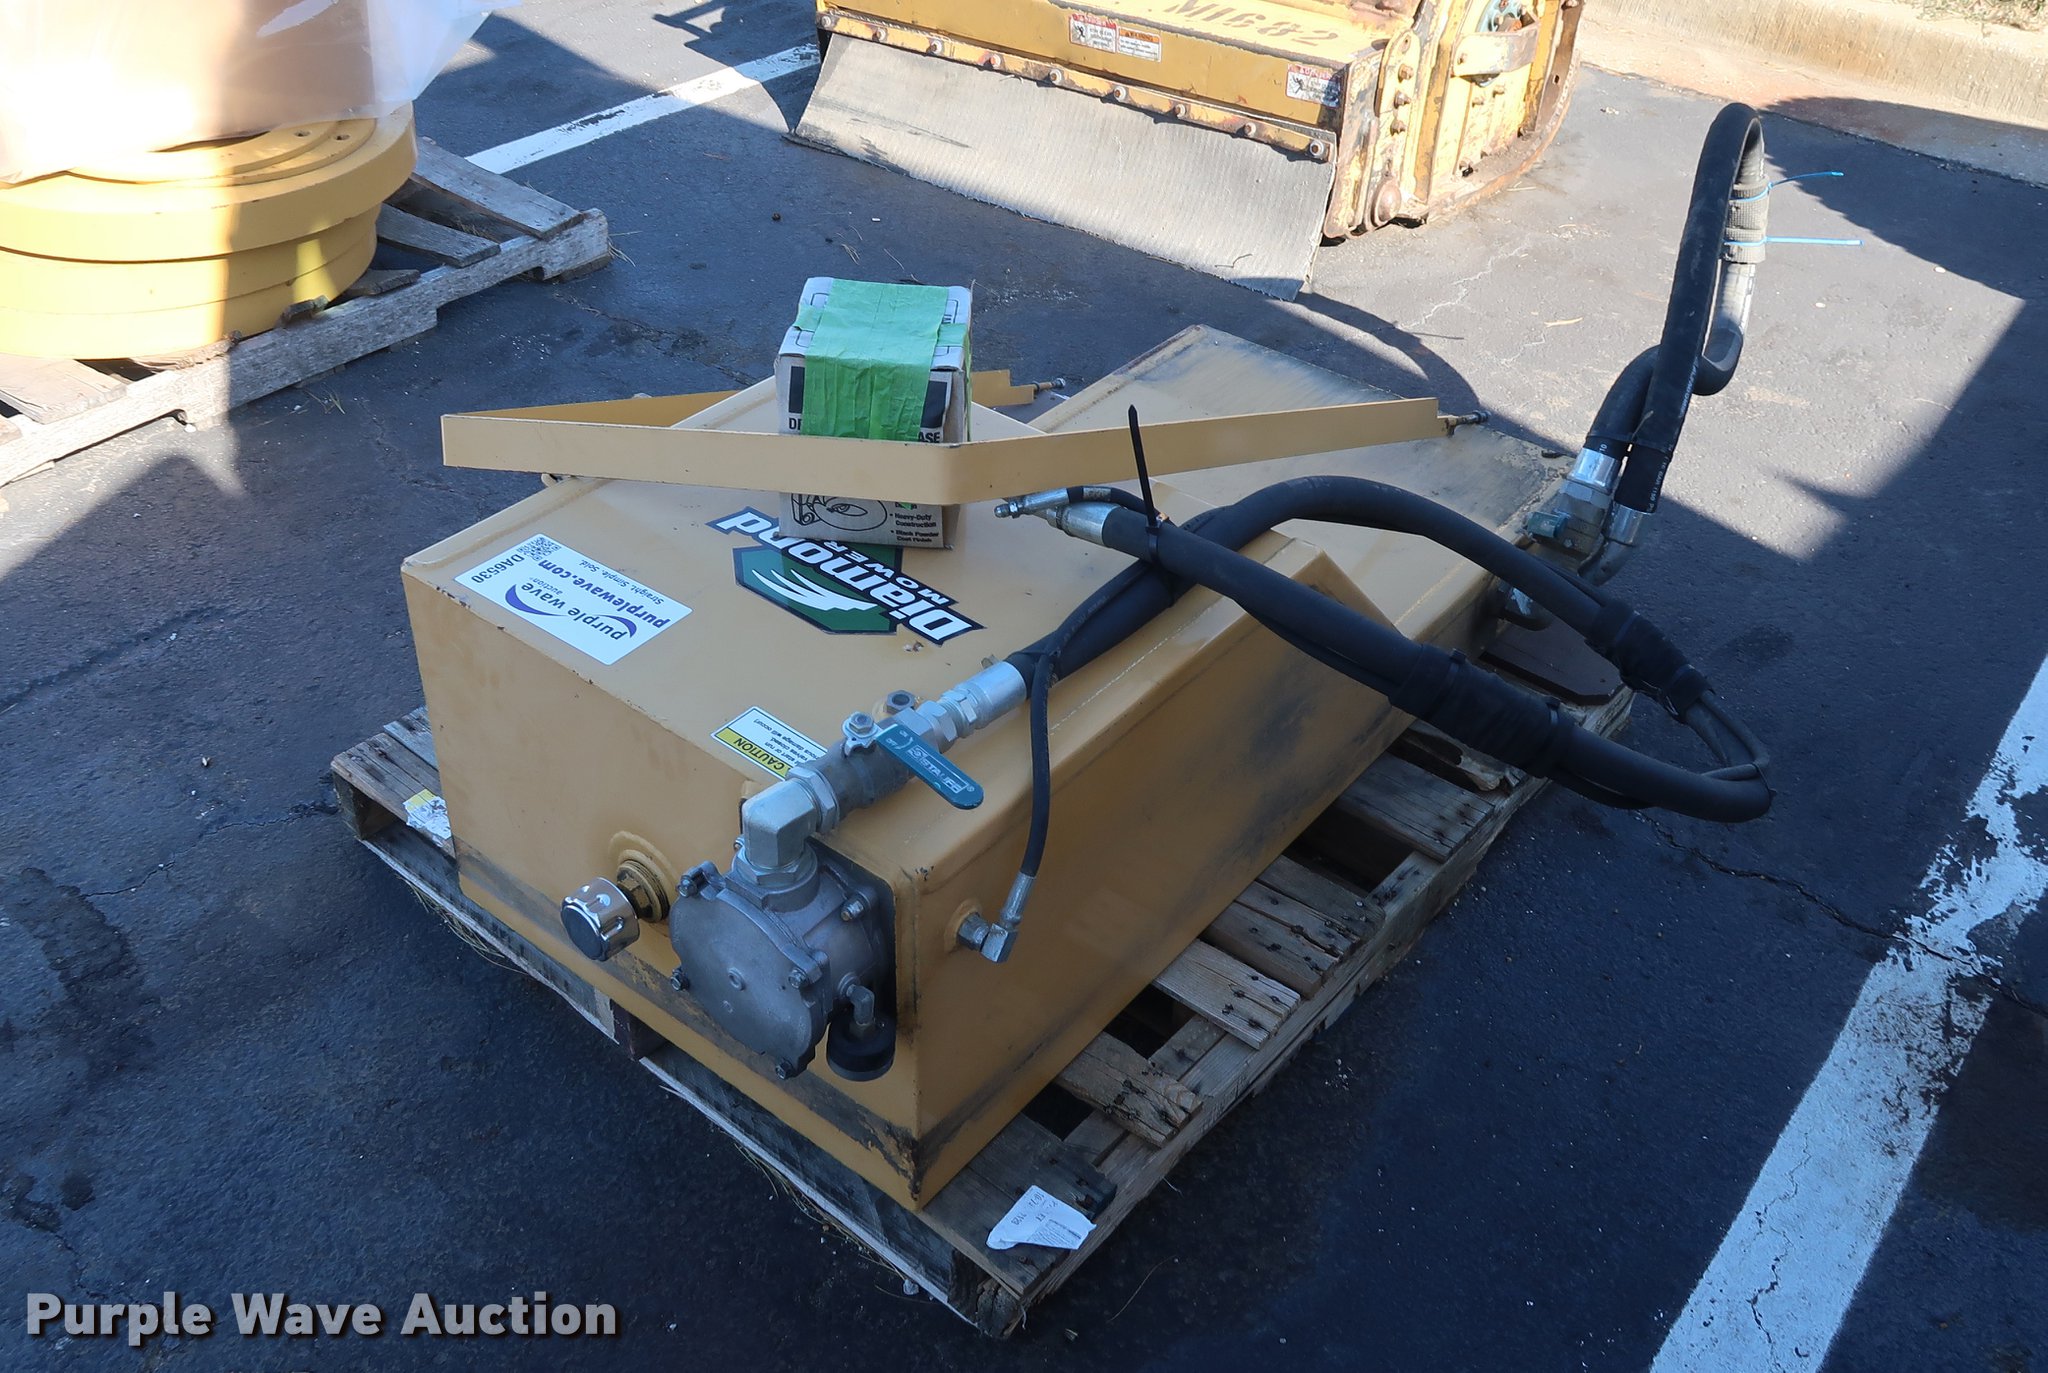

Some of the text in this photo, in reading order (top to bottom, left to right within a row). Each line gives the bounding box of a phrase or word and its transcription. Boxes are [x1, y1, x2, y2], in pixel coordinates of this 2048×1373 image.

[894, 512, 932, 521] Heavy-Duty
[895, 520, 937, 528] Construction
[471, 553, 525, 584] DA6530
[579, 559, 665, 605] Straight. Simple. Sold.
[716, 511, 974, 641] Diamond
[823, 540, 950, 605] MOWER
[532, 578, 563, 595] auction
[537, 559, 671, 629] purplewave.com
[520, 582, 628, 640] purple wave
[733, 737, 785, 770] CAUTION
[764, 741, 776, 750] run
[782, 736, 805, 751] damage
